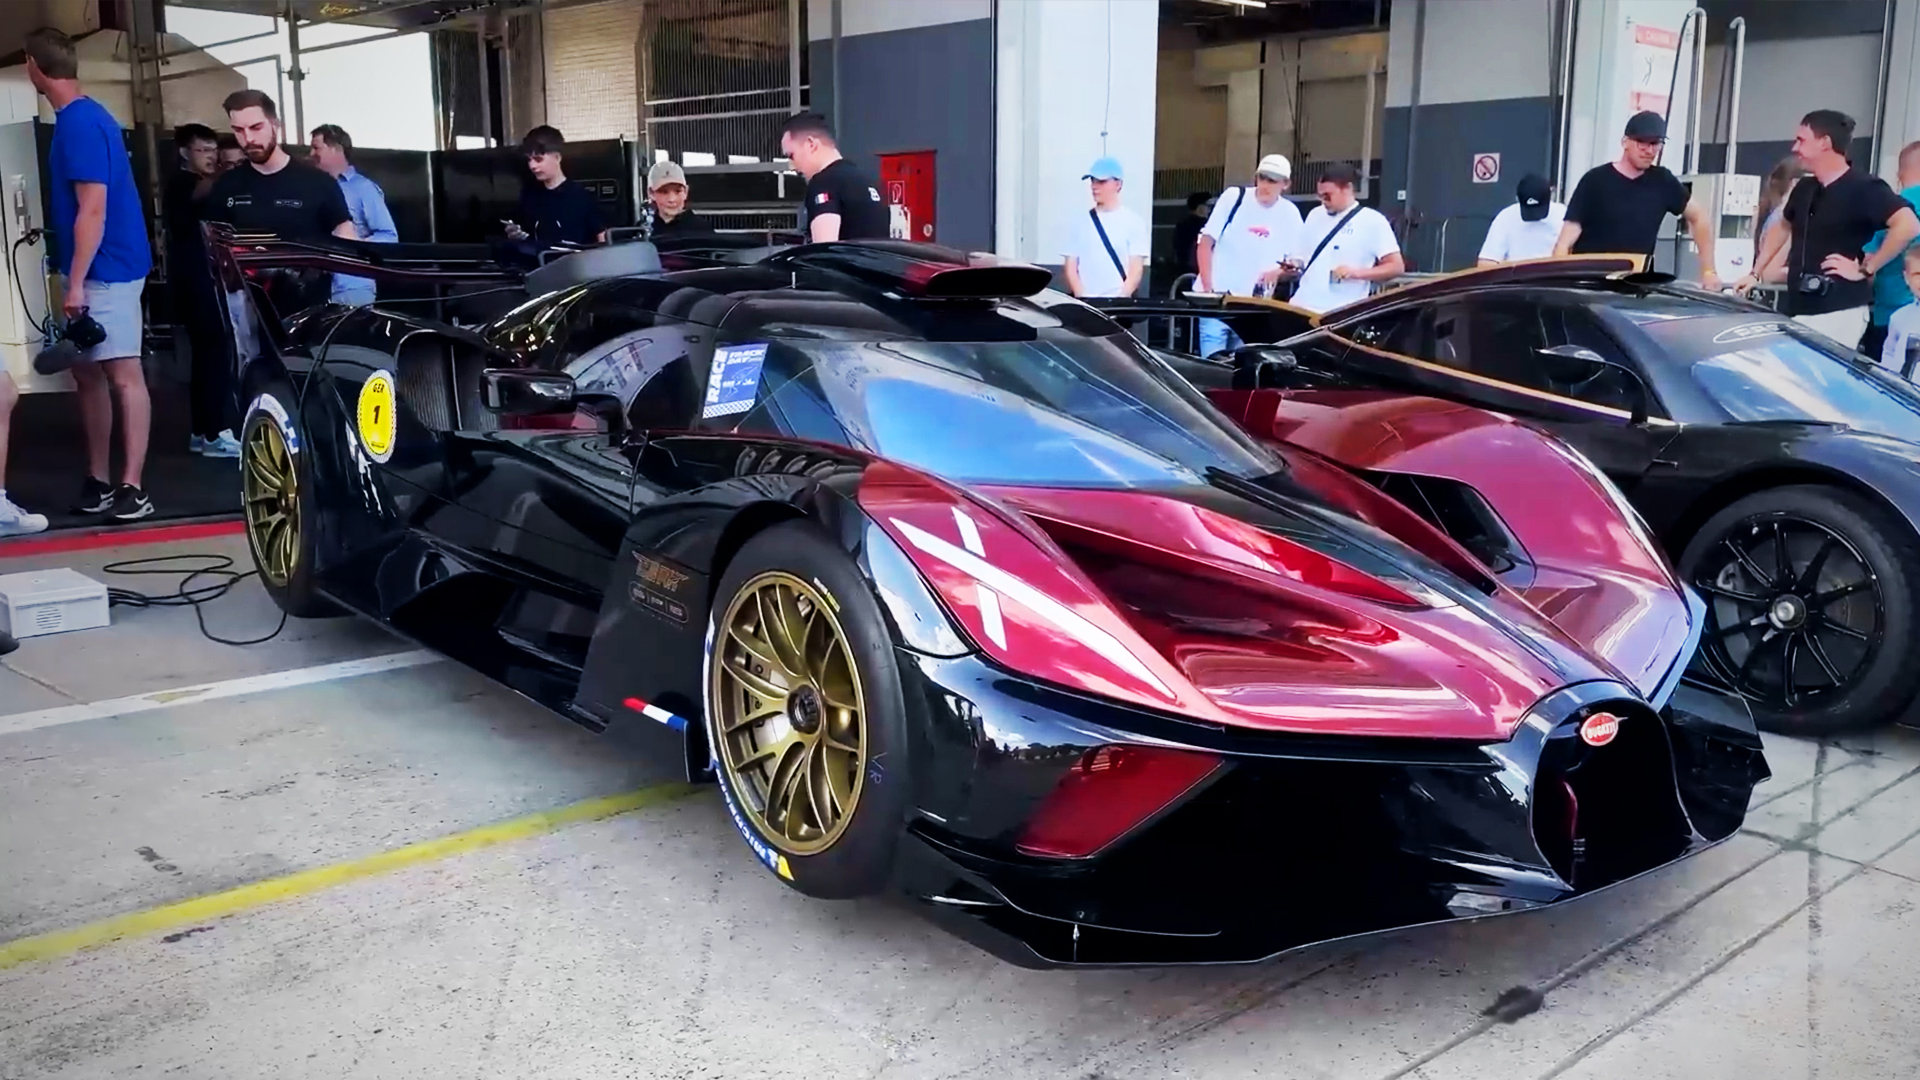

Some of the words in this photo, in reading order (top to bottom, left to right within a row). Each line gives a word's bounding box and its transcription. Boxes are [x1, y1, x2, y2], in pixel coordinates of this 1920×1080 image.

[706, 348, 728, 403] RACE
[372, 383, 385, 393] GER
[373, 405, 381, 424] 1
[1586, 721, 1616, 740] BUGATTI
